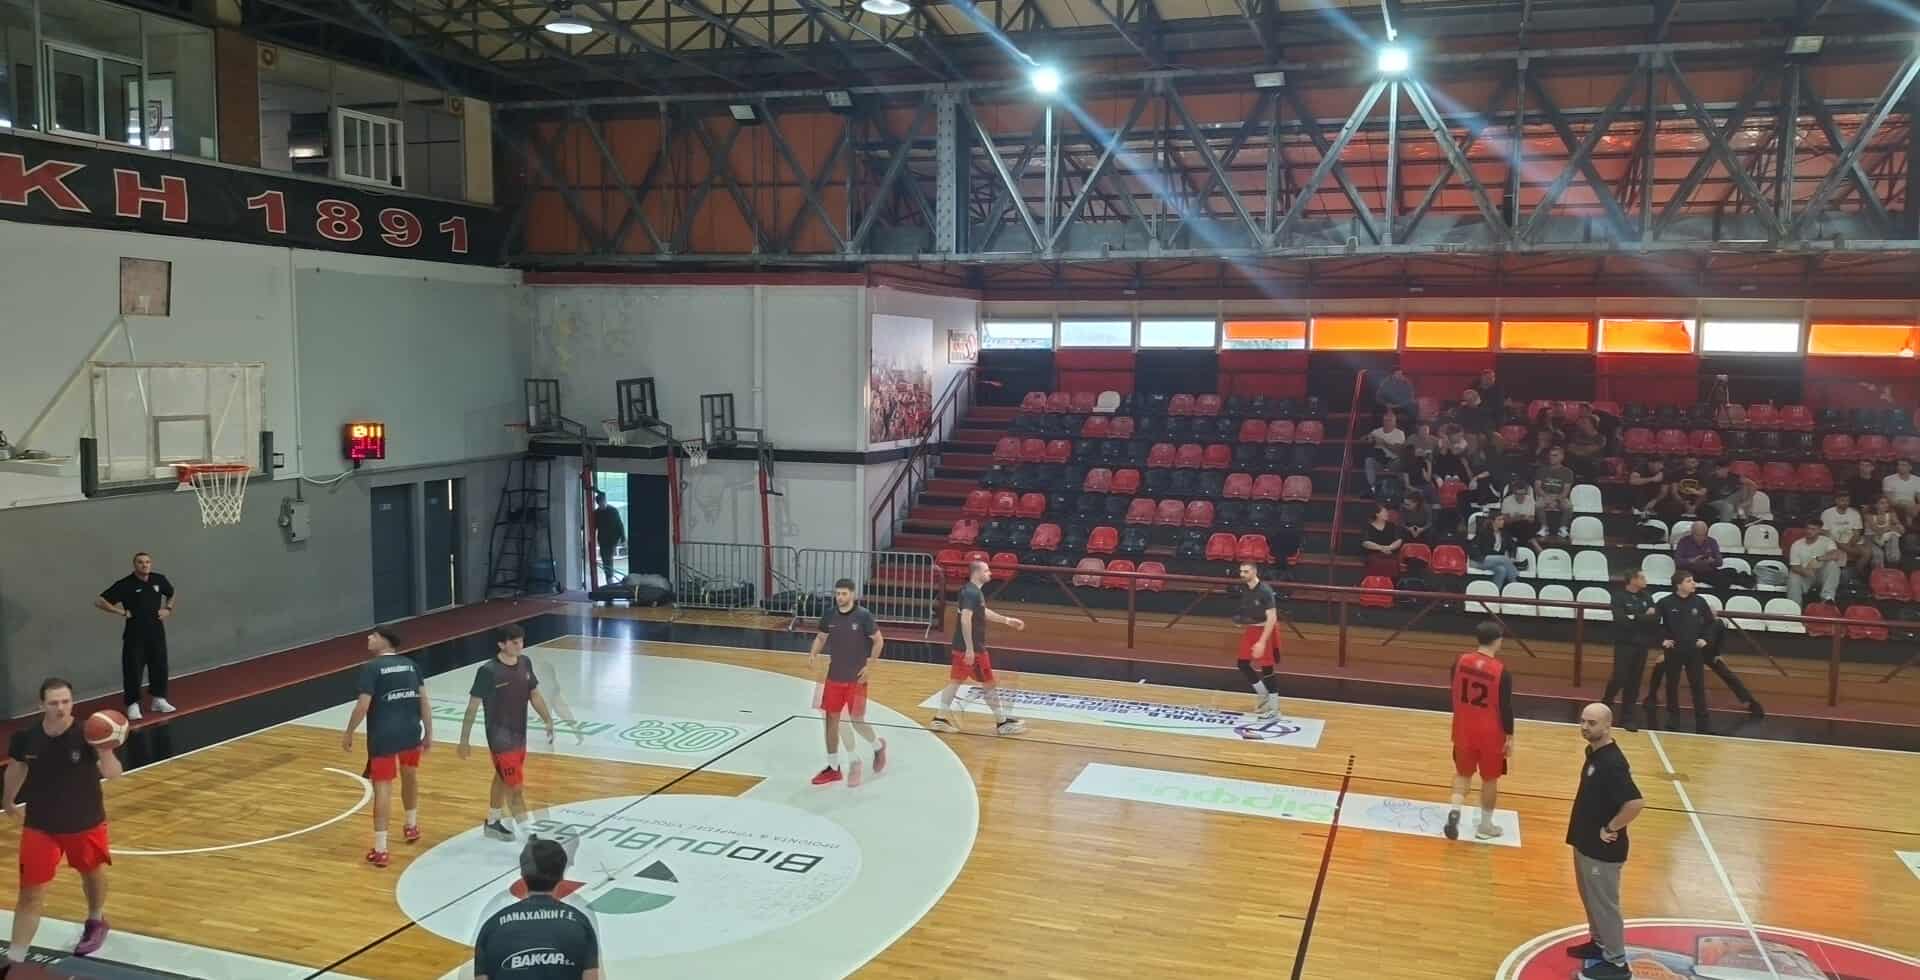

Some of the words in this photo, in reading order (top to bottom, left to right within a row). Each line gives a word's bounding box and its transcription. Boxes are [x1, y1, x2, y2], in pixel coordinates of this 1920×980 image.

[247, 190, 468, 254] 1891
[351, 437, 381, 458] 24
[1461, 678, 1488, 708] 12
